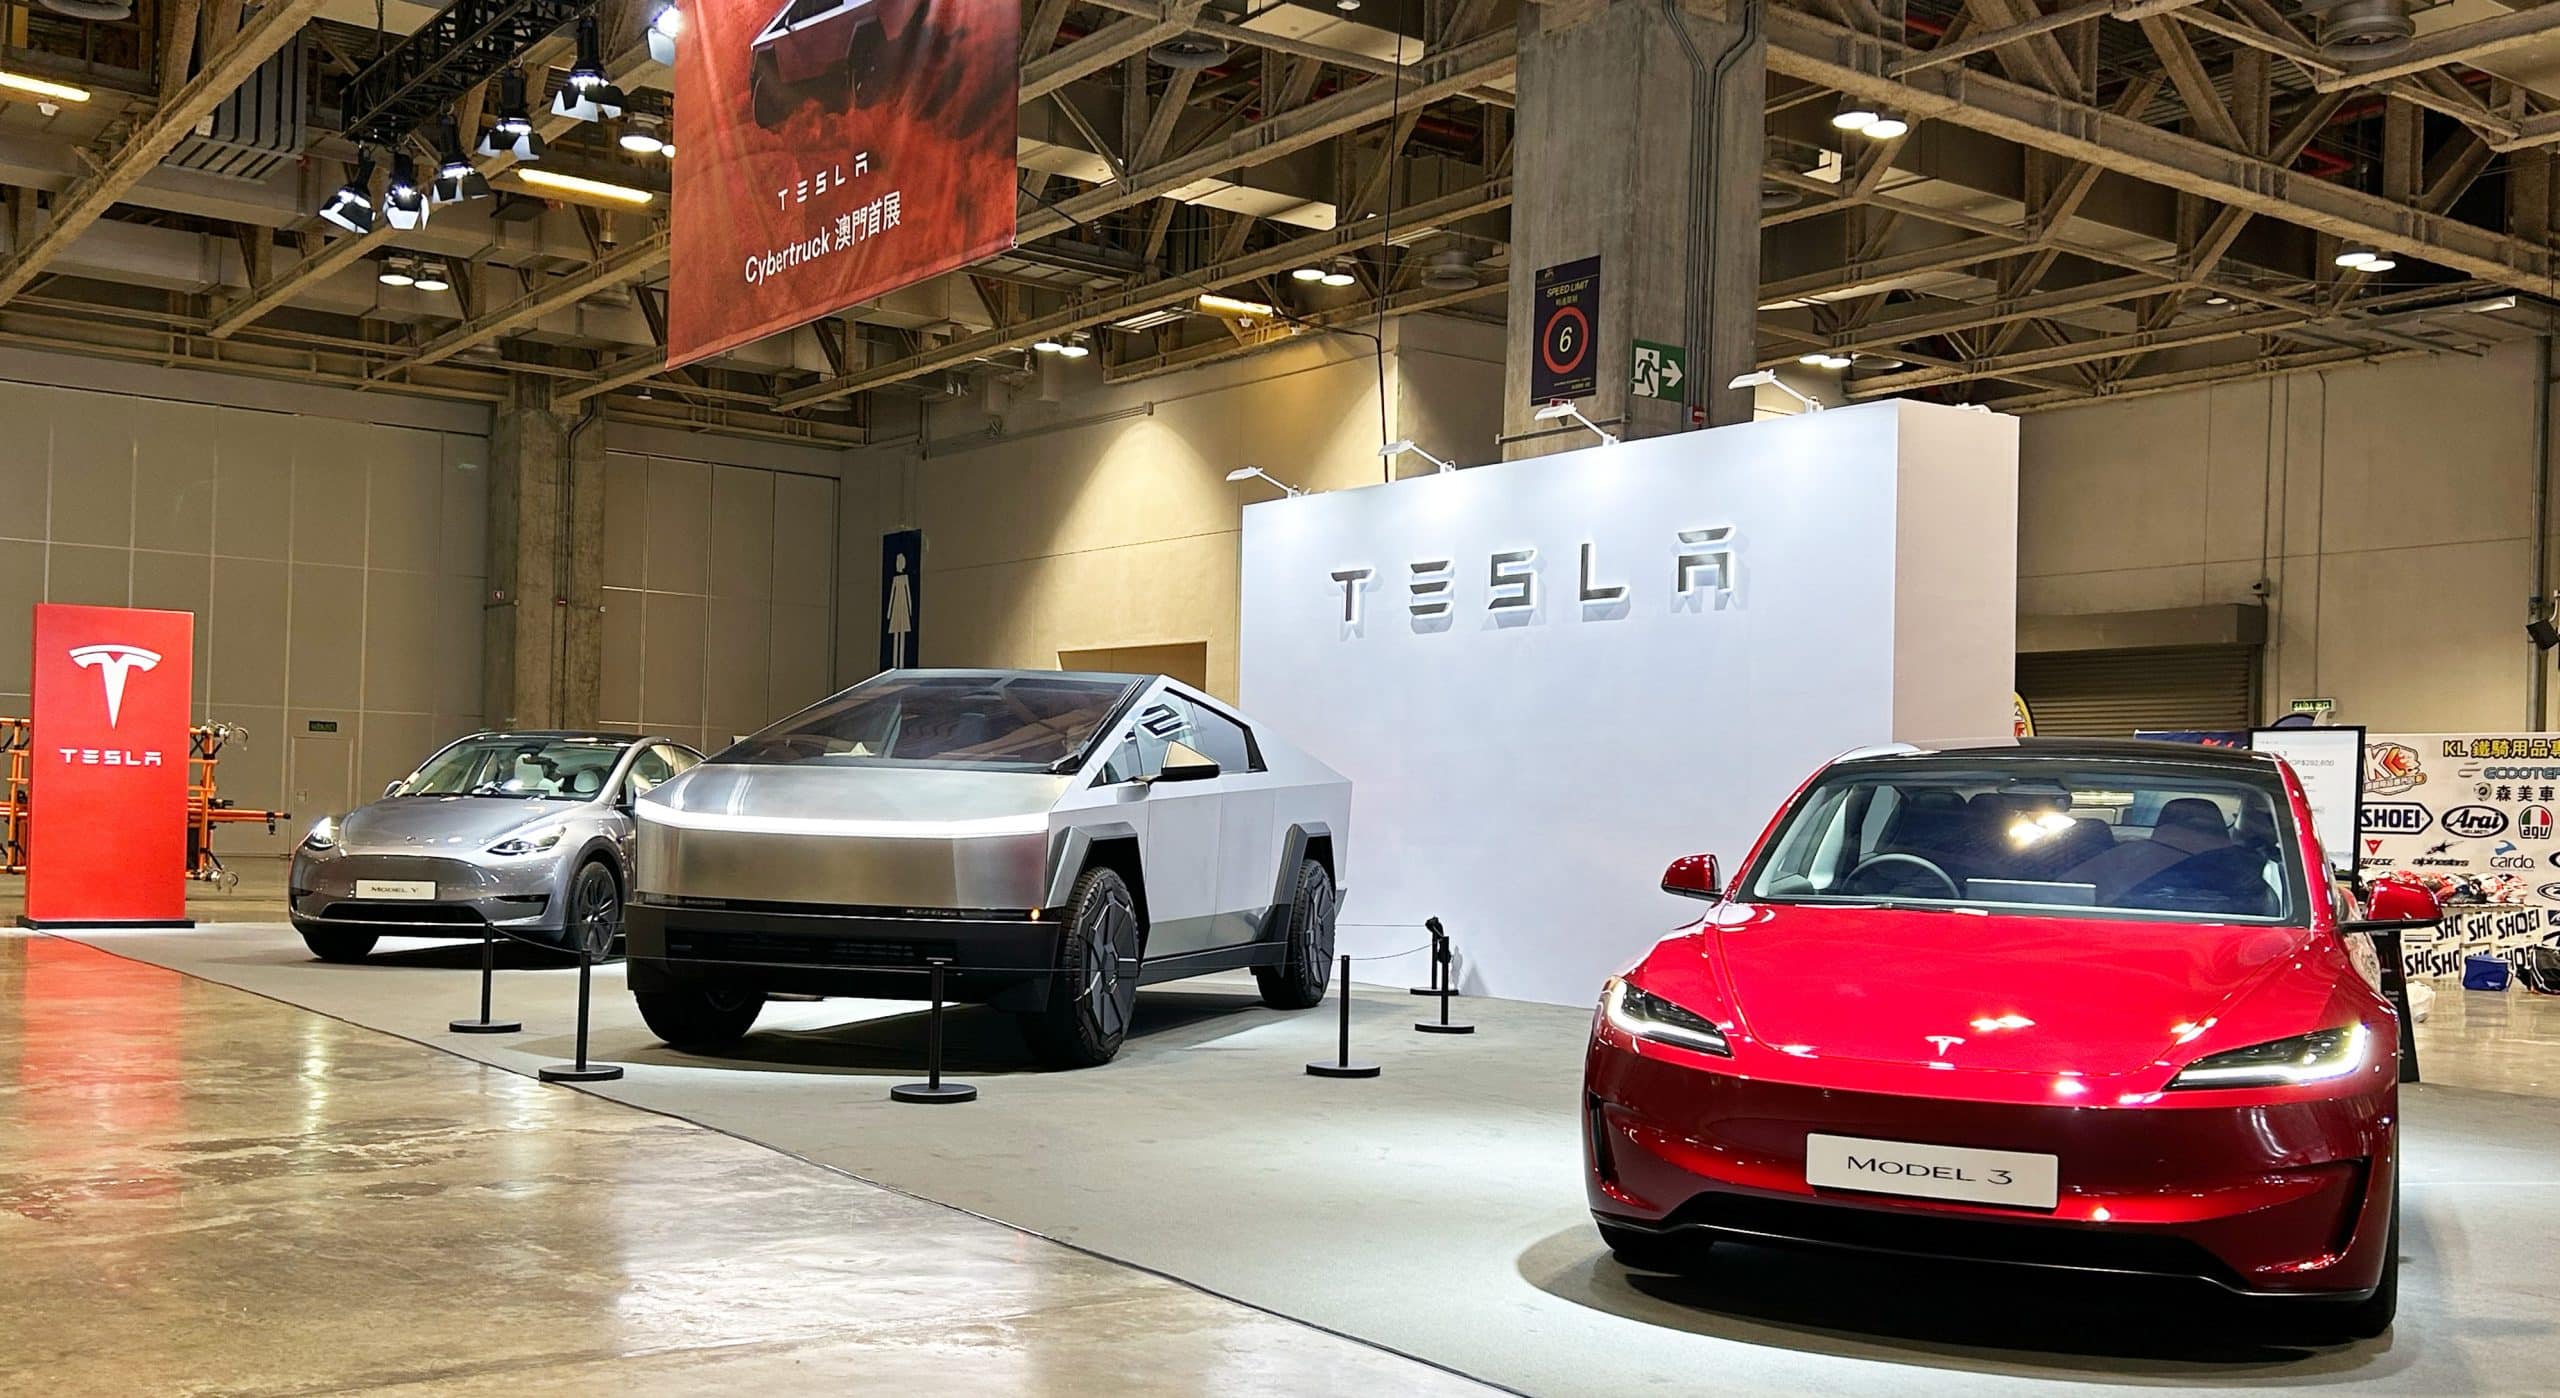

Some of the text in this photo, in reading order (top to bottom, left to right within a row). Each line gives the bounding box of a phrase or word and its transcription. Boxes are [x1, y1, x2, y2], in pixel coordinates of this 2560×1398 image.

[777, 151, 869, 211] TESLA
[744, 190, 901, 286] Cybertruck 澳門首展
[1546, 284, 1570, 298] SPEED
[1559, 326, 1573, 353] 6
[1331, 526, 1735, 623] TESLA
[59, 748, 163, 767] TESLA
[2443, 740, 2468, 757] KL
[2361, 808, 2421, 829] SHOEI
[2446, 809, 2501, 829] Arai
[2522, 825, 2549, 839] agv
[2490, 854, 2534, 869] cardo
[2496, 908, 2540, 940] SHOEI
[1847, 1155, 2013, 1186] MODEL 3
